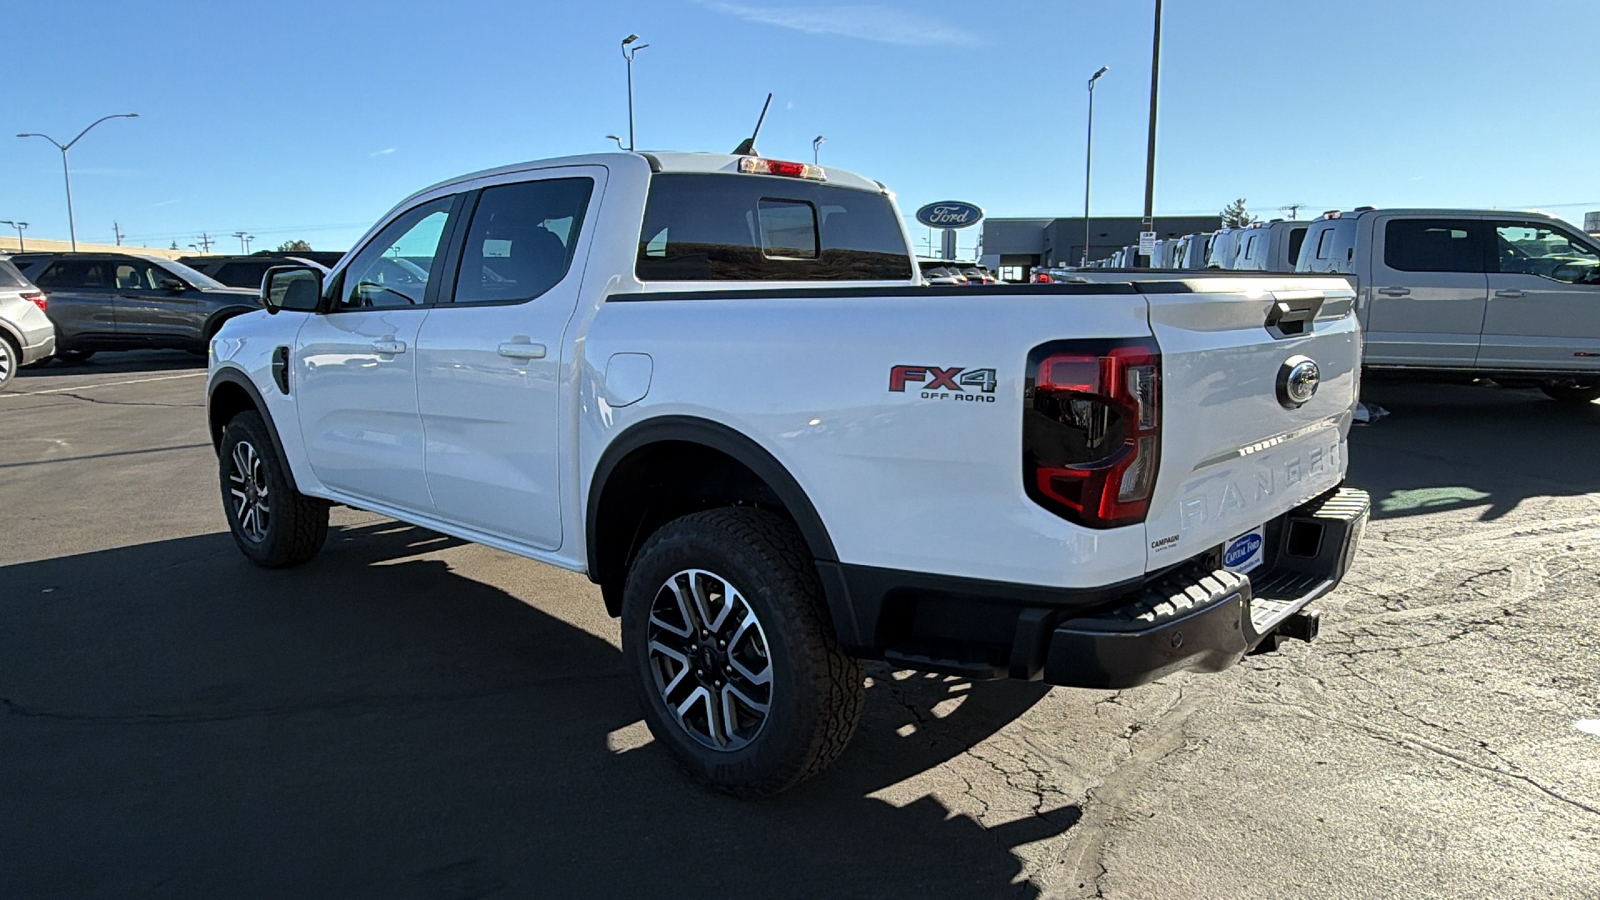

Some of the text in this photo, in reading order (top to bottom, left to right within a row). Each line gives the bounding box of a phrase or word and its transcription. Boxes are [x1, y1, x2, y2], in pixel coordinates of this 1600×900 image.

[930, 206, 969, 223] Ford
[888, 364, 997, 393] FX4
[920, 391, 996, 403] OFF ROAD
